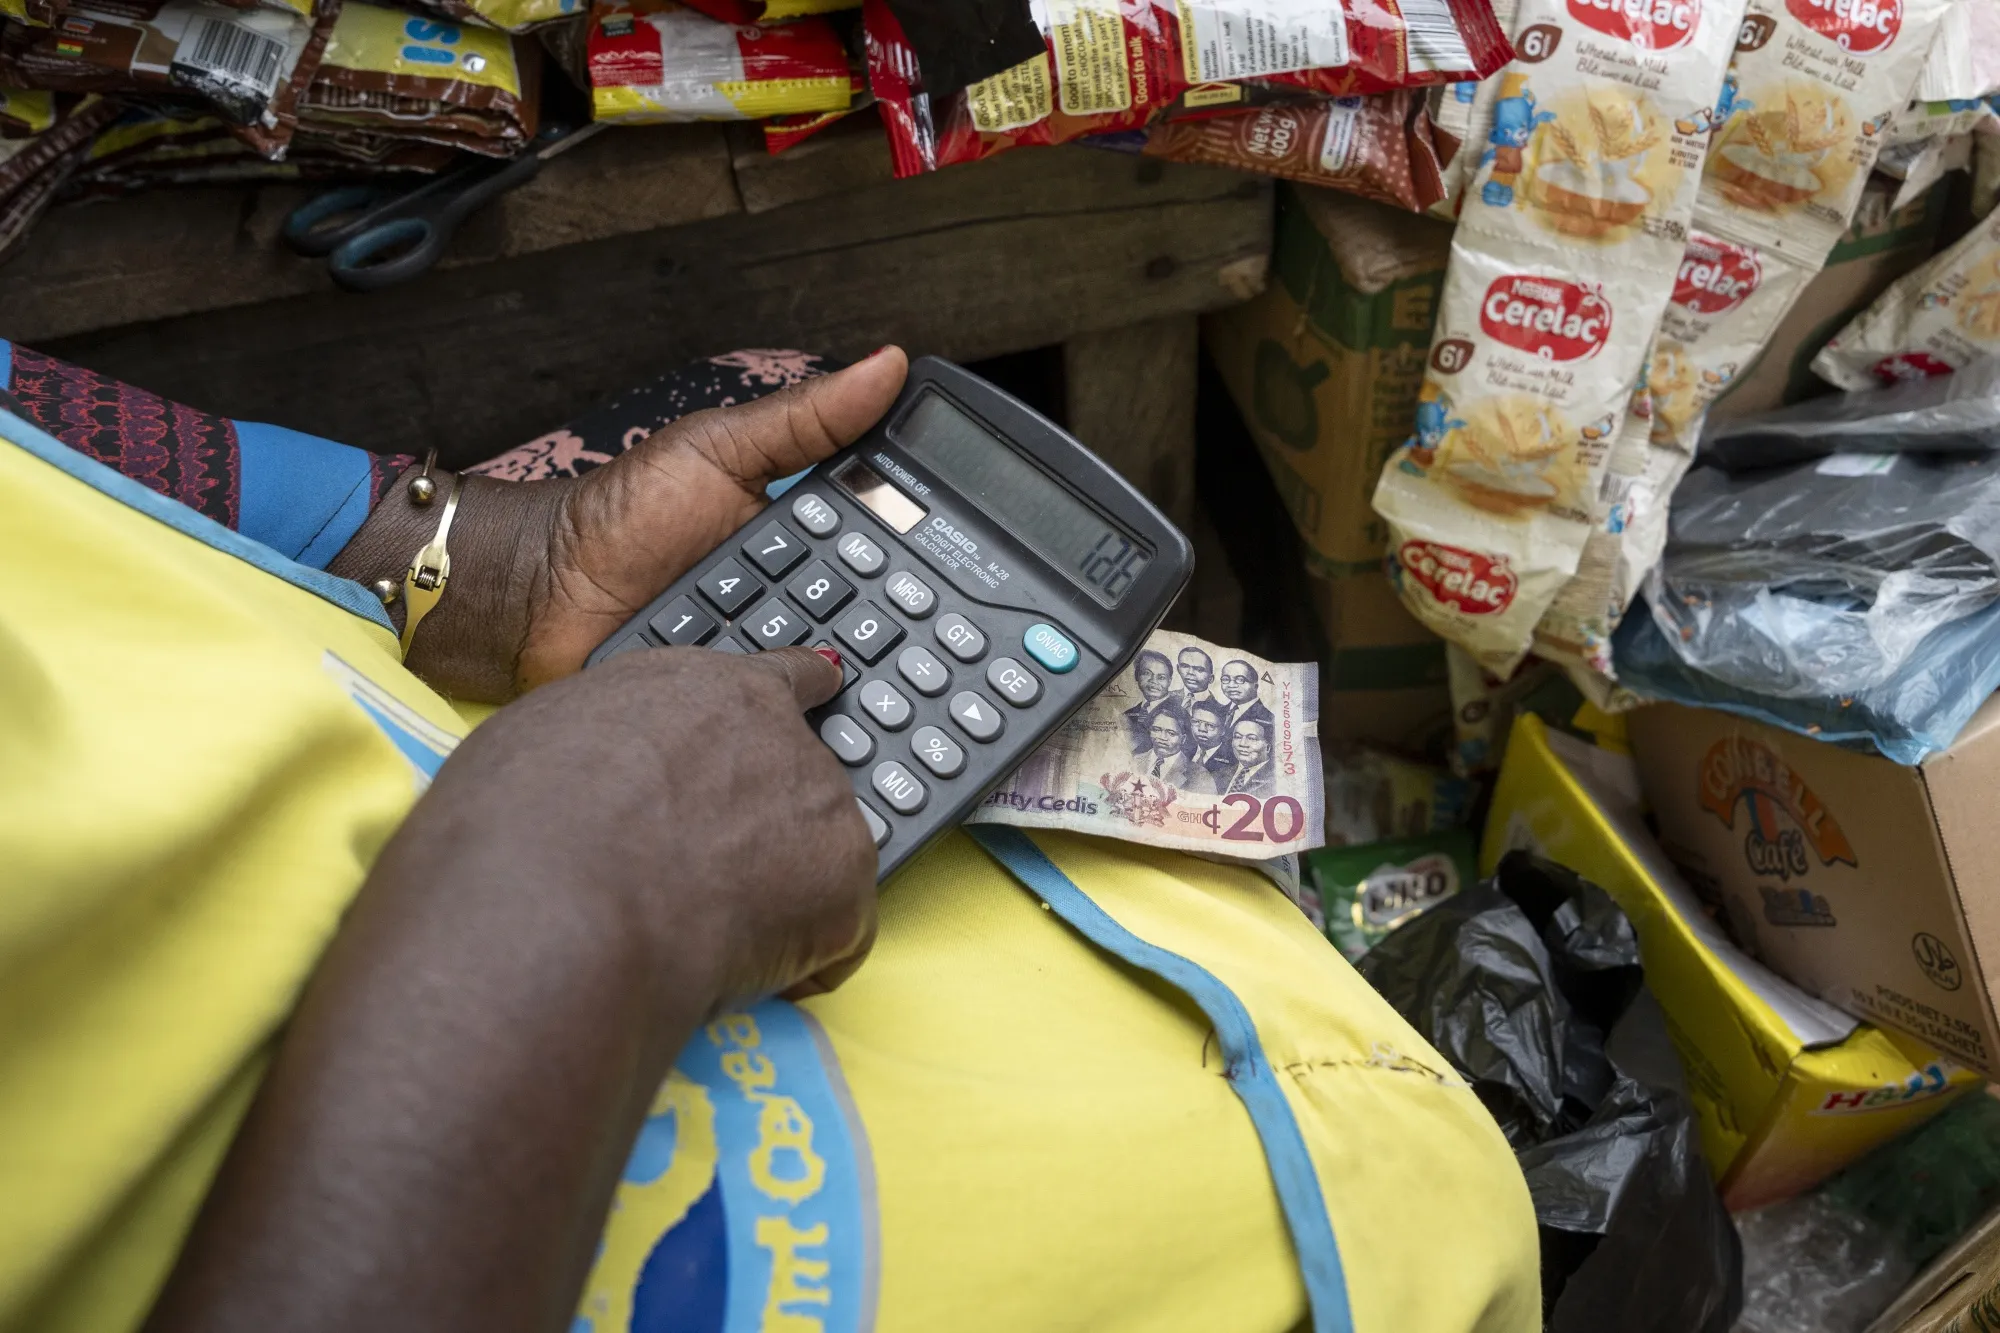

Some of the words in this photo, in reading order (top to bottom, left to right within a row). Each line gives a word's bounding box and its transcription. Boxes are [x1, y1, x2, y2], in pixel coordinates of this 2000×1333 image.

[1128, 36, 1144, 57] talk
[1524, 30, 1544, 57] 6
[1066, 69, 1077, 83] to
[1132, 59, 1146, 72] to
[1066, 82, 1080, 109] Good
[1133, 73, 1148, 104] Good
[1248, 127, 1271, 154] Net
[1270, 118, 1298, 158] 400g
[1485, 291, 1601, 343] Cerelac
[873, 452, 893, 469] AUTO
[891, 465, 918, 490] POWER
[914, 483, 931, 497] OFF
[800, 500, 827, 525] M+
[761, 535, 788, 555] 7
[931, 517, 978, 554] QASIO
[914, 532, 960, 571] CALCULATOR
[923, 526, 955, 552] 12-DIGIT
[952, 549, 1000, 589] ELECTRONIC
[987, 562, 1010, 581] M-28
[1402, 546, 1505, 607] Cerelac
[718, 577, 741, 595] 4
[805, 578, 830, 600] 8
[892, 577, 925, 606] MRC
[671, 614, 693, 633] 1
[762, 615, 788, 637] 5
[854, 619, 879, 641] 9
[946, 624, 975, 648] GT
[1035, 630, 1069, 660] ON/AC
[1000, 668, 1027, 694] CE
[881, 770, 914, 800] MU
[1037, 794, 1099, 815] Cedis
[1928, 1023, 1987, 1060] SACHETS
